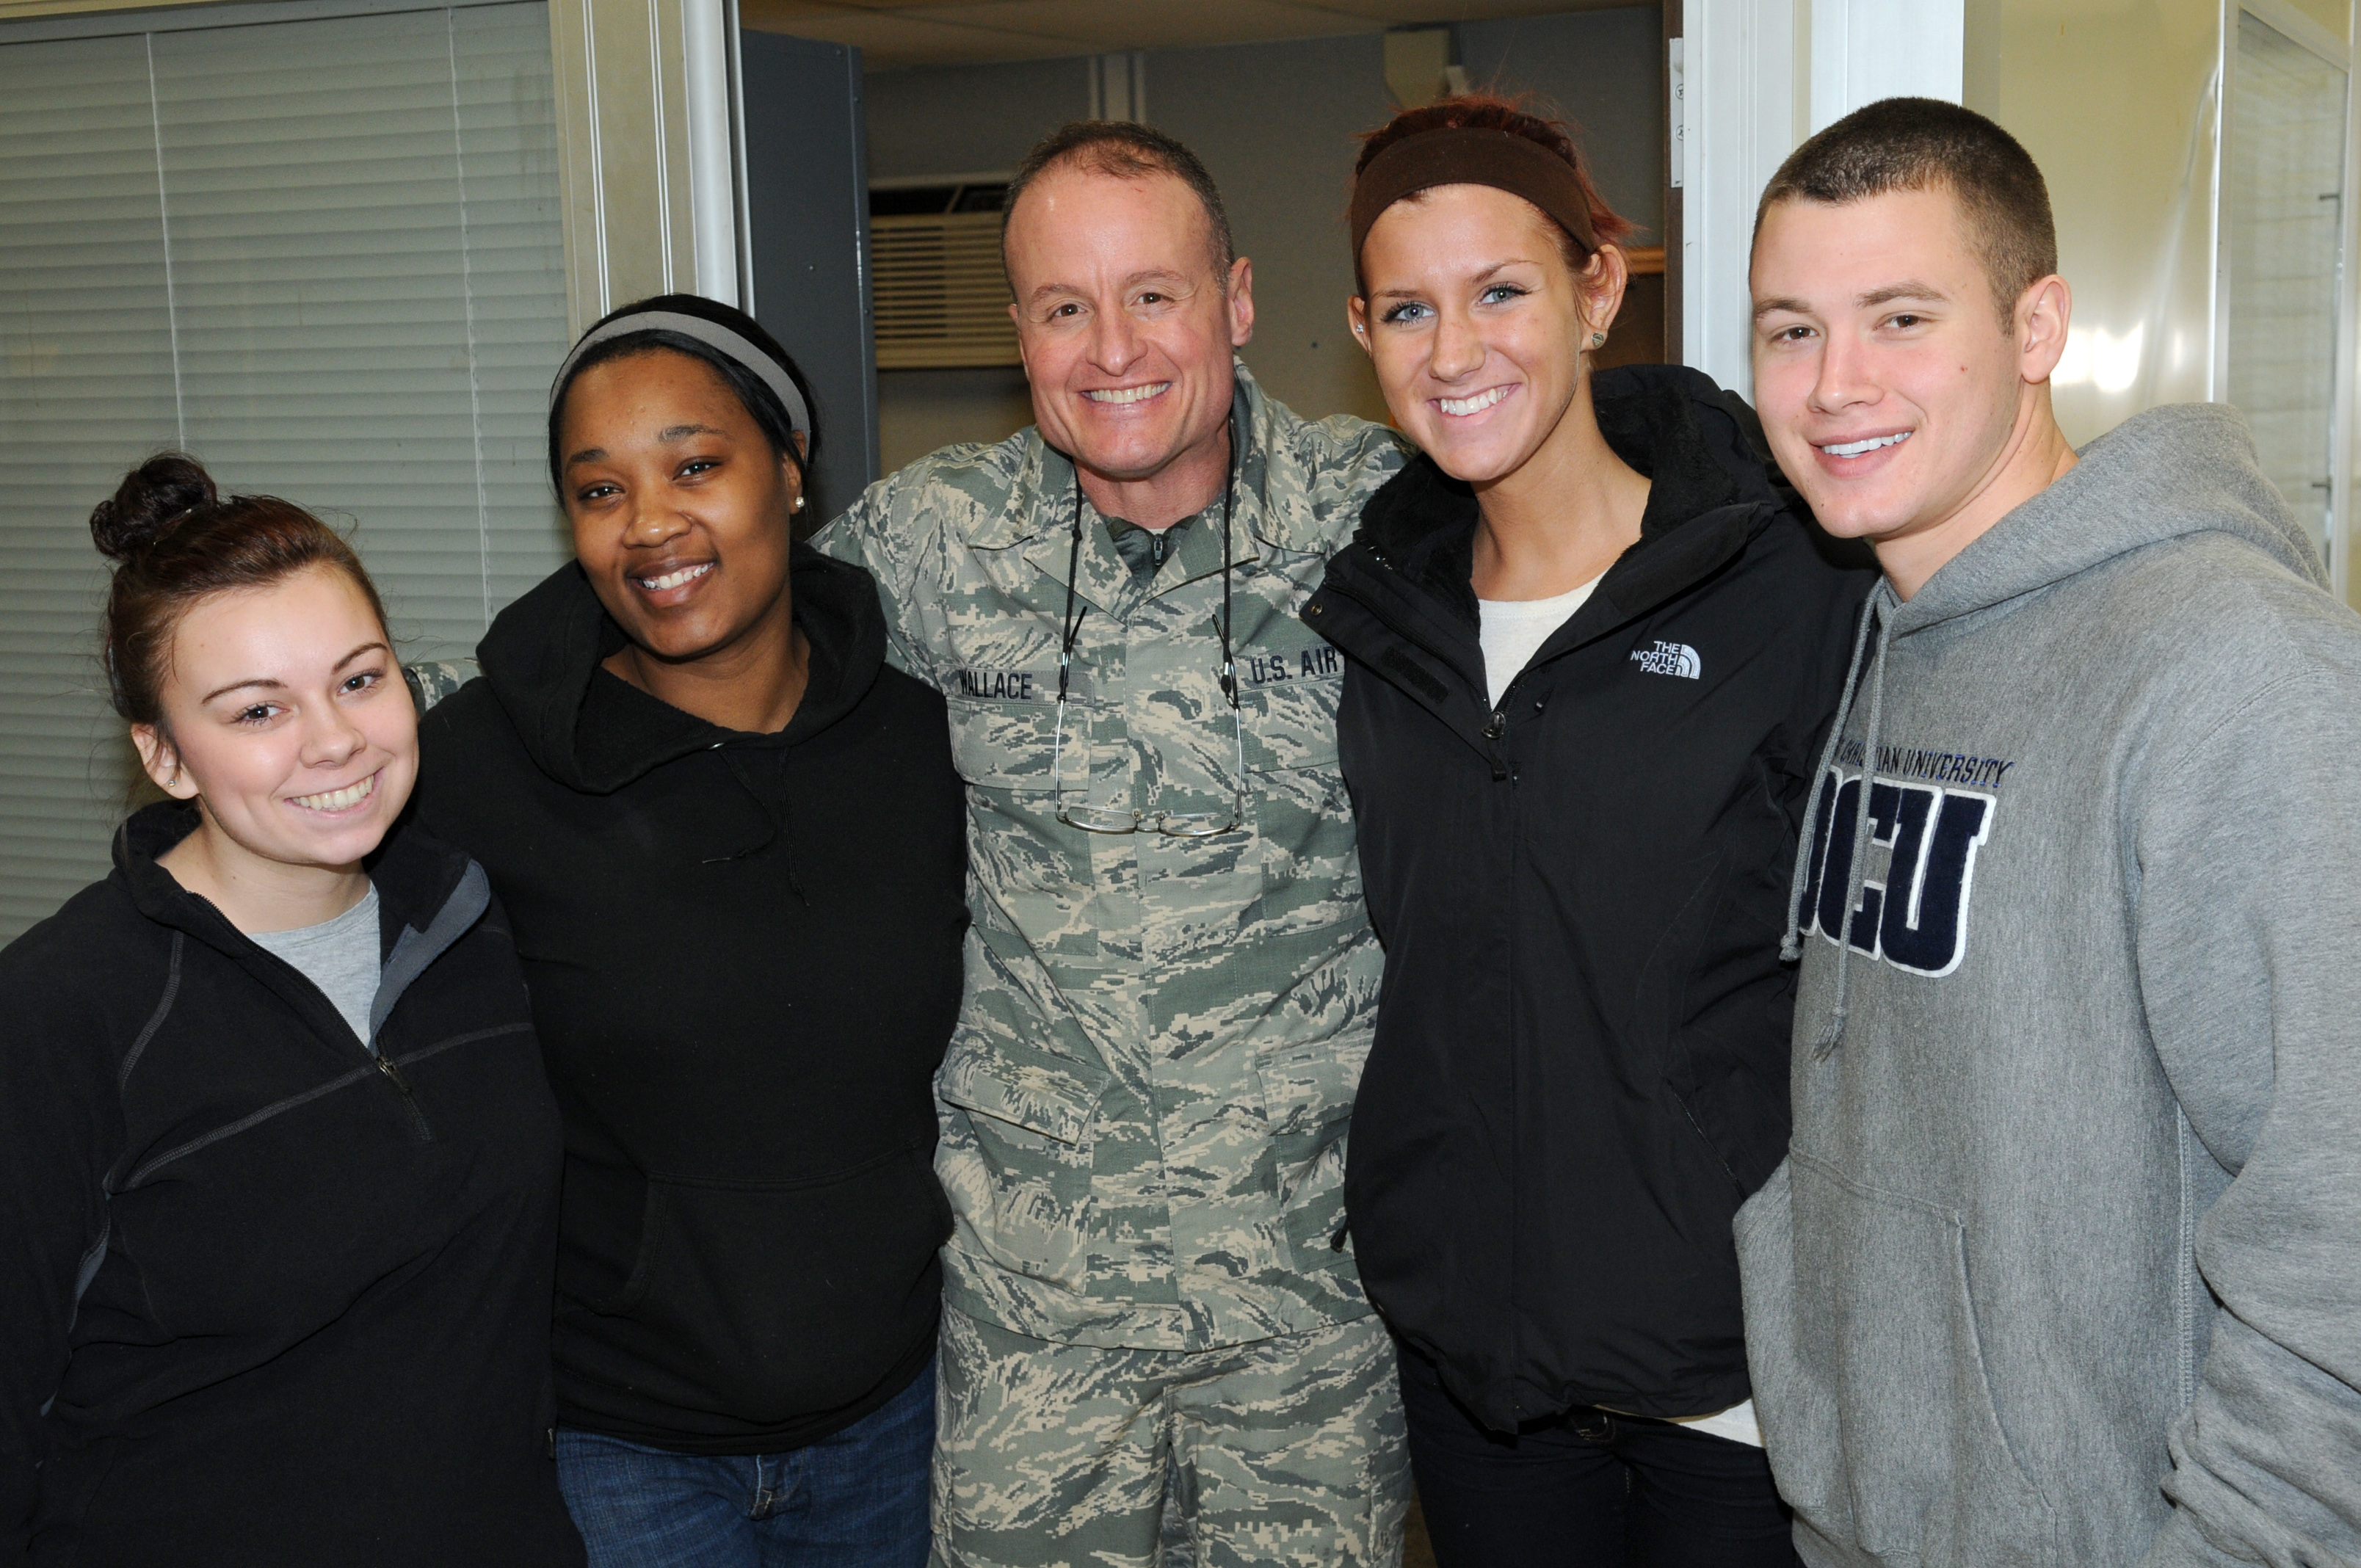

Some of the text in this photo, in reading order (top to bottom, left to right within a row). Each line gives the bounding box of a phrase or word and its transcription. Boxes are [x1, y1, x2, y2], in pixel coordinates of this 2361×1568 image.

[1630, 650, 1678, 666] NORTH
[1653, 640, 1680, 654] THE
[1250, 646, 1338, 684] U.S. AIR
[1639, 661, 1675, 675] FACE
[958, 669, 1033, 700] WALLACE
[1903, 749, 2014, 788] UNIVERSITY
